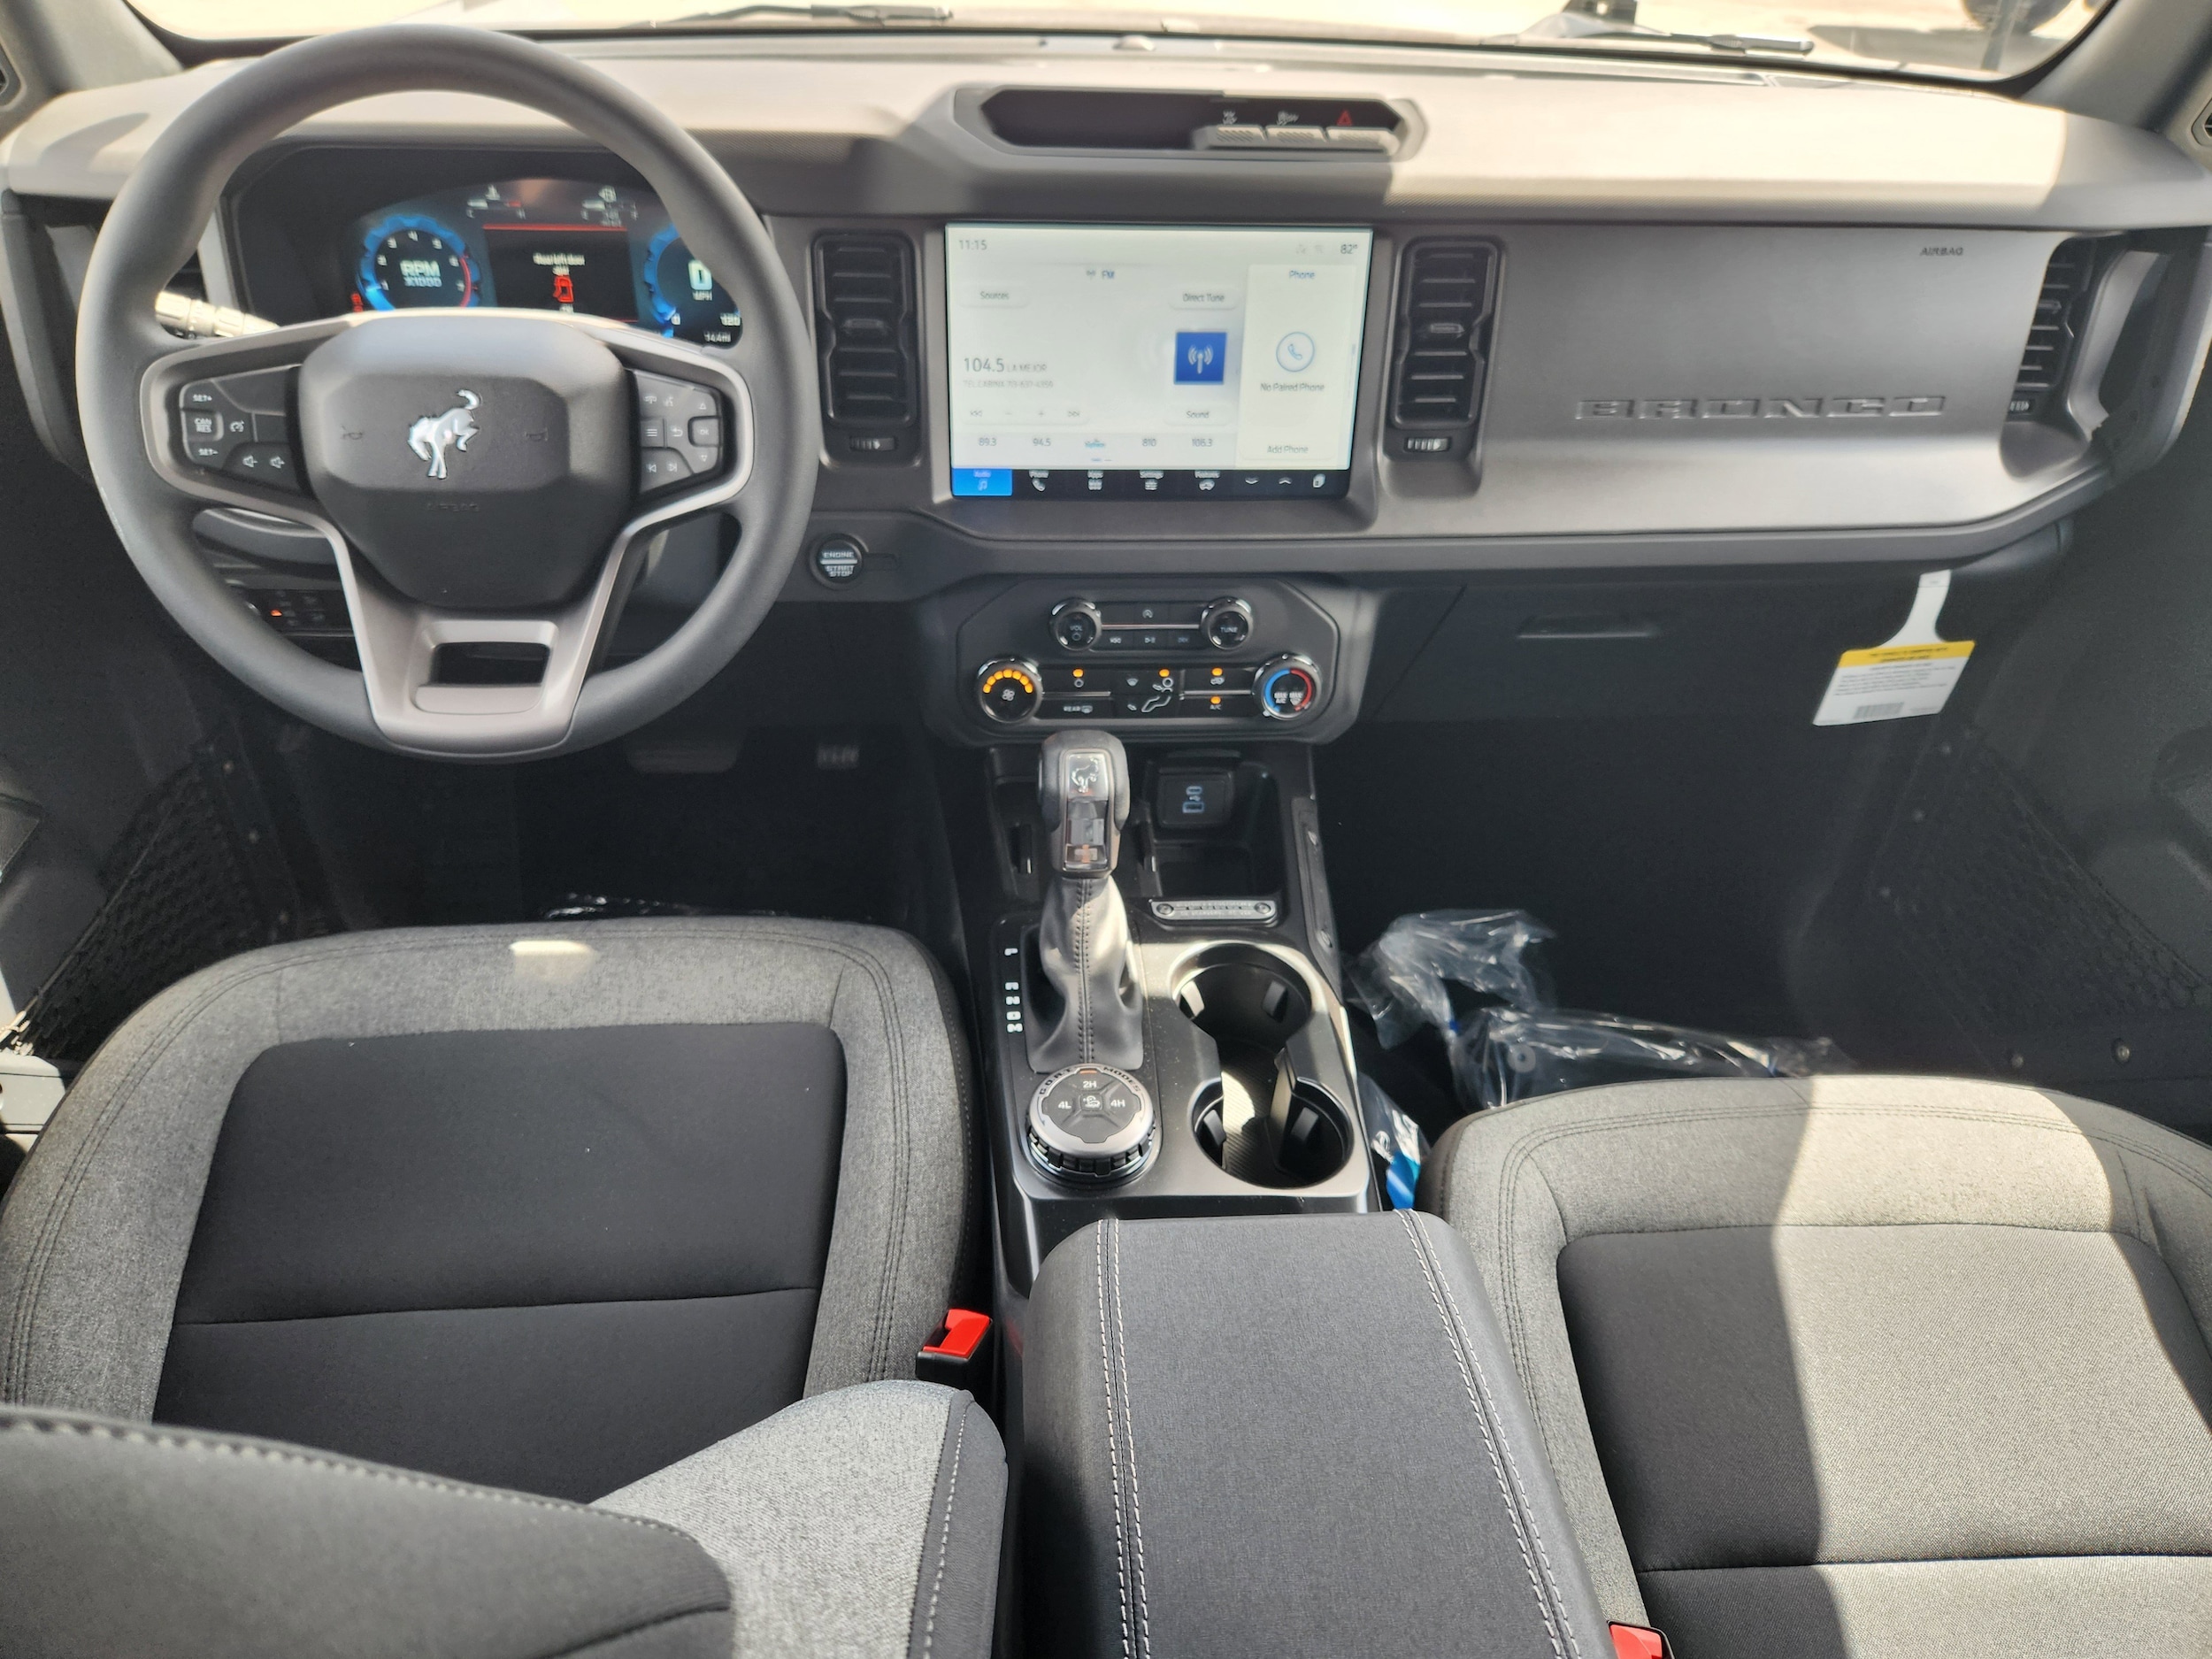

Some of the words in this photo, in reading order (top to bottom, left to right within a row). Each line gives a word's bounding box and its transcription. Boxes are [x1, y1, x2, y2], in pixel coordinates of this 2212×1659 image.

[958, 239, 987, 250] 11:15
[400, 259, 441, 277] RPM
[1102, 270, 1115, 279] FM
[1289, 271, 1316, 280] Phone
[980, 291, 1010, 300] Sources
[1182, 293, 1204, 303] Direct
[1206, 293, 1225, 303] Tune
[964, 357, 1004, 373] 104.5
[1260, 383, 1271, 392] No
[1273, 383, 1299, 392] Paired
[1300, 383, 1325, 392] Phone
[1576, 396, 1946, 419] BRONCO
[1187, 411, 1210, 419] Sound
[979, 437, 997, 446] 89.3
[1033, 437, 1051, 446] 94.5
[1103, 1066, 1142, 1092] MODES
[1082, 1080, 1097, 1089] 2H
[1057, 1101, 1072, 1110] 4L
[1110, 1099, 1125, 1108] 4H
